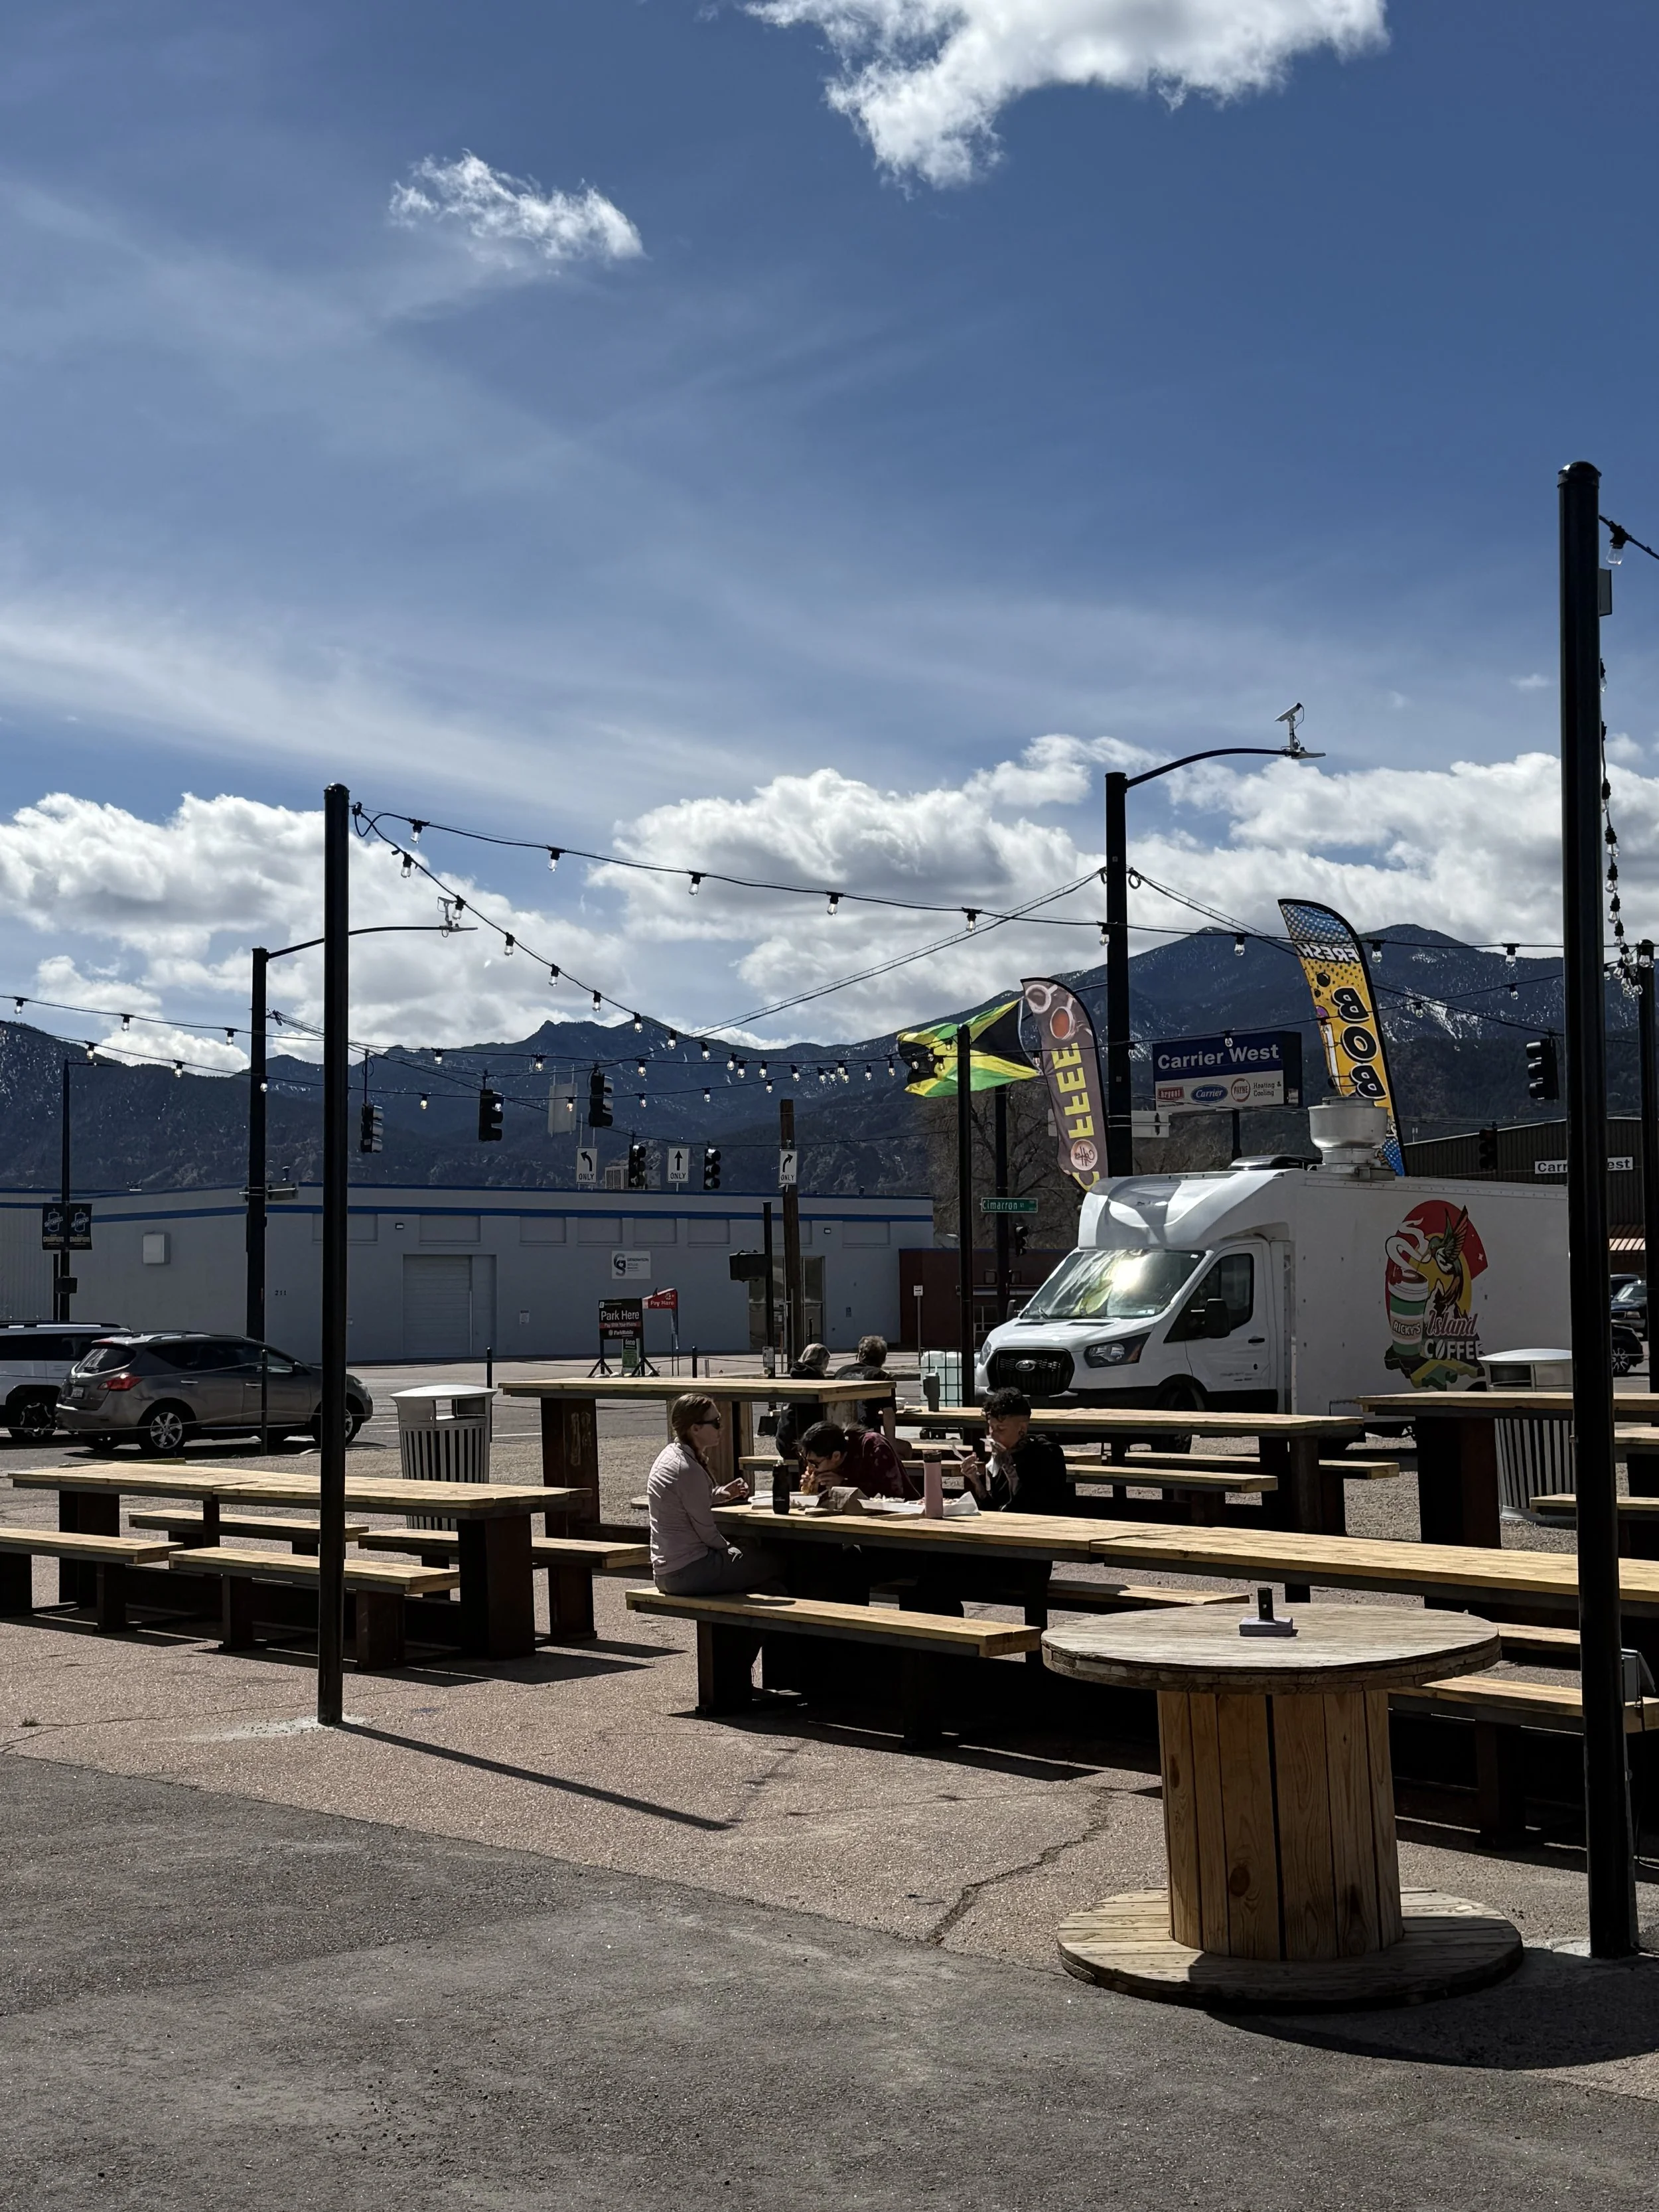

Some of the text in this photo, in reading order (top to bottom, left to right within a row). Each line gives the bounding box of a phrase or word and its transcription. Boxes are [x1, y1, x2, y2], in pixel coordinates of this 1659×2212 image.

[1157, 1044, 1279, 1070] Carrier West
[1195, 1088, 1224, 1098] Carrier
[1234, 1085, 1248, 1094] PAYNE
[1538, 1159, 1630, 1172] Carr est
[982, 1199, 1018, 1210] Cimarron
[601, 1309, 640, 1321] Park Here
[1427, 1308, 1479, 1337] Island
